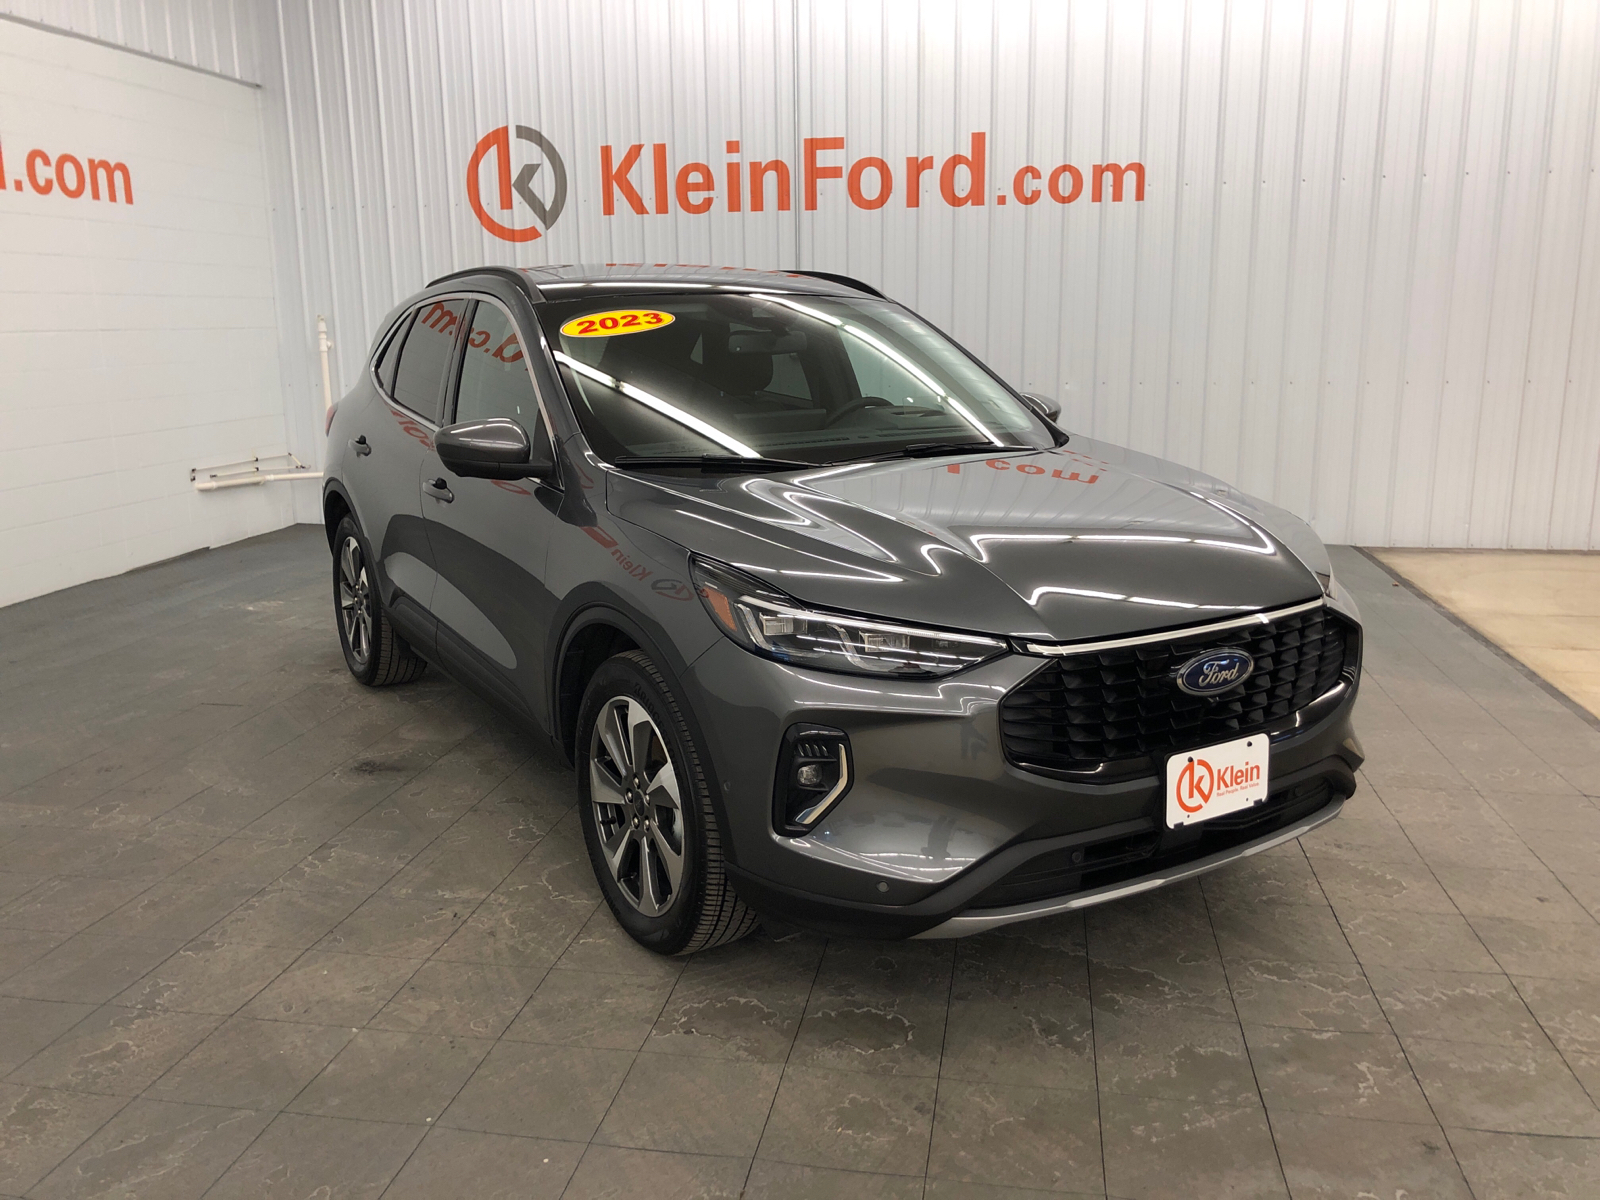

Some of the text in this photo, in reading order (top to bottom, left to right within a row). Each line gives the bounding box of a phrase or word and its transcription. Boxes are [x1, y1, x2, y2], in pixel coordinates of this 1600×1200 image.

[0, 134, 134, 205] .com
[600, 131, 1146, 216] KleinFord.com
[576, 312, 664, 335] 2023
[1198, 659, 1240, 687] Ford
[1216, 761, 1260, 791] Klein
